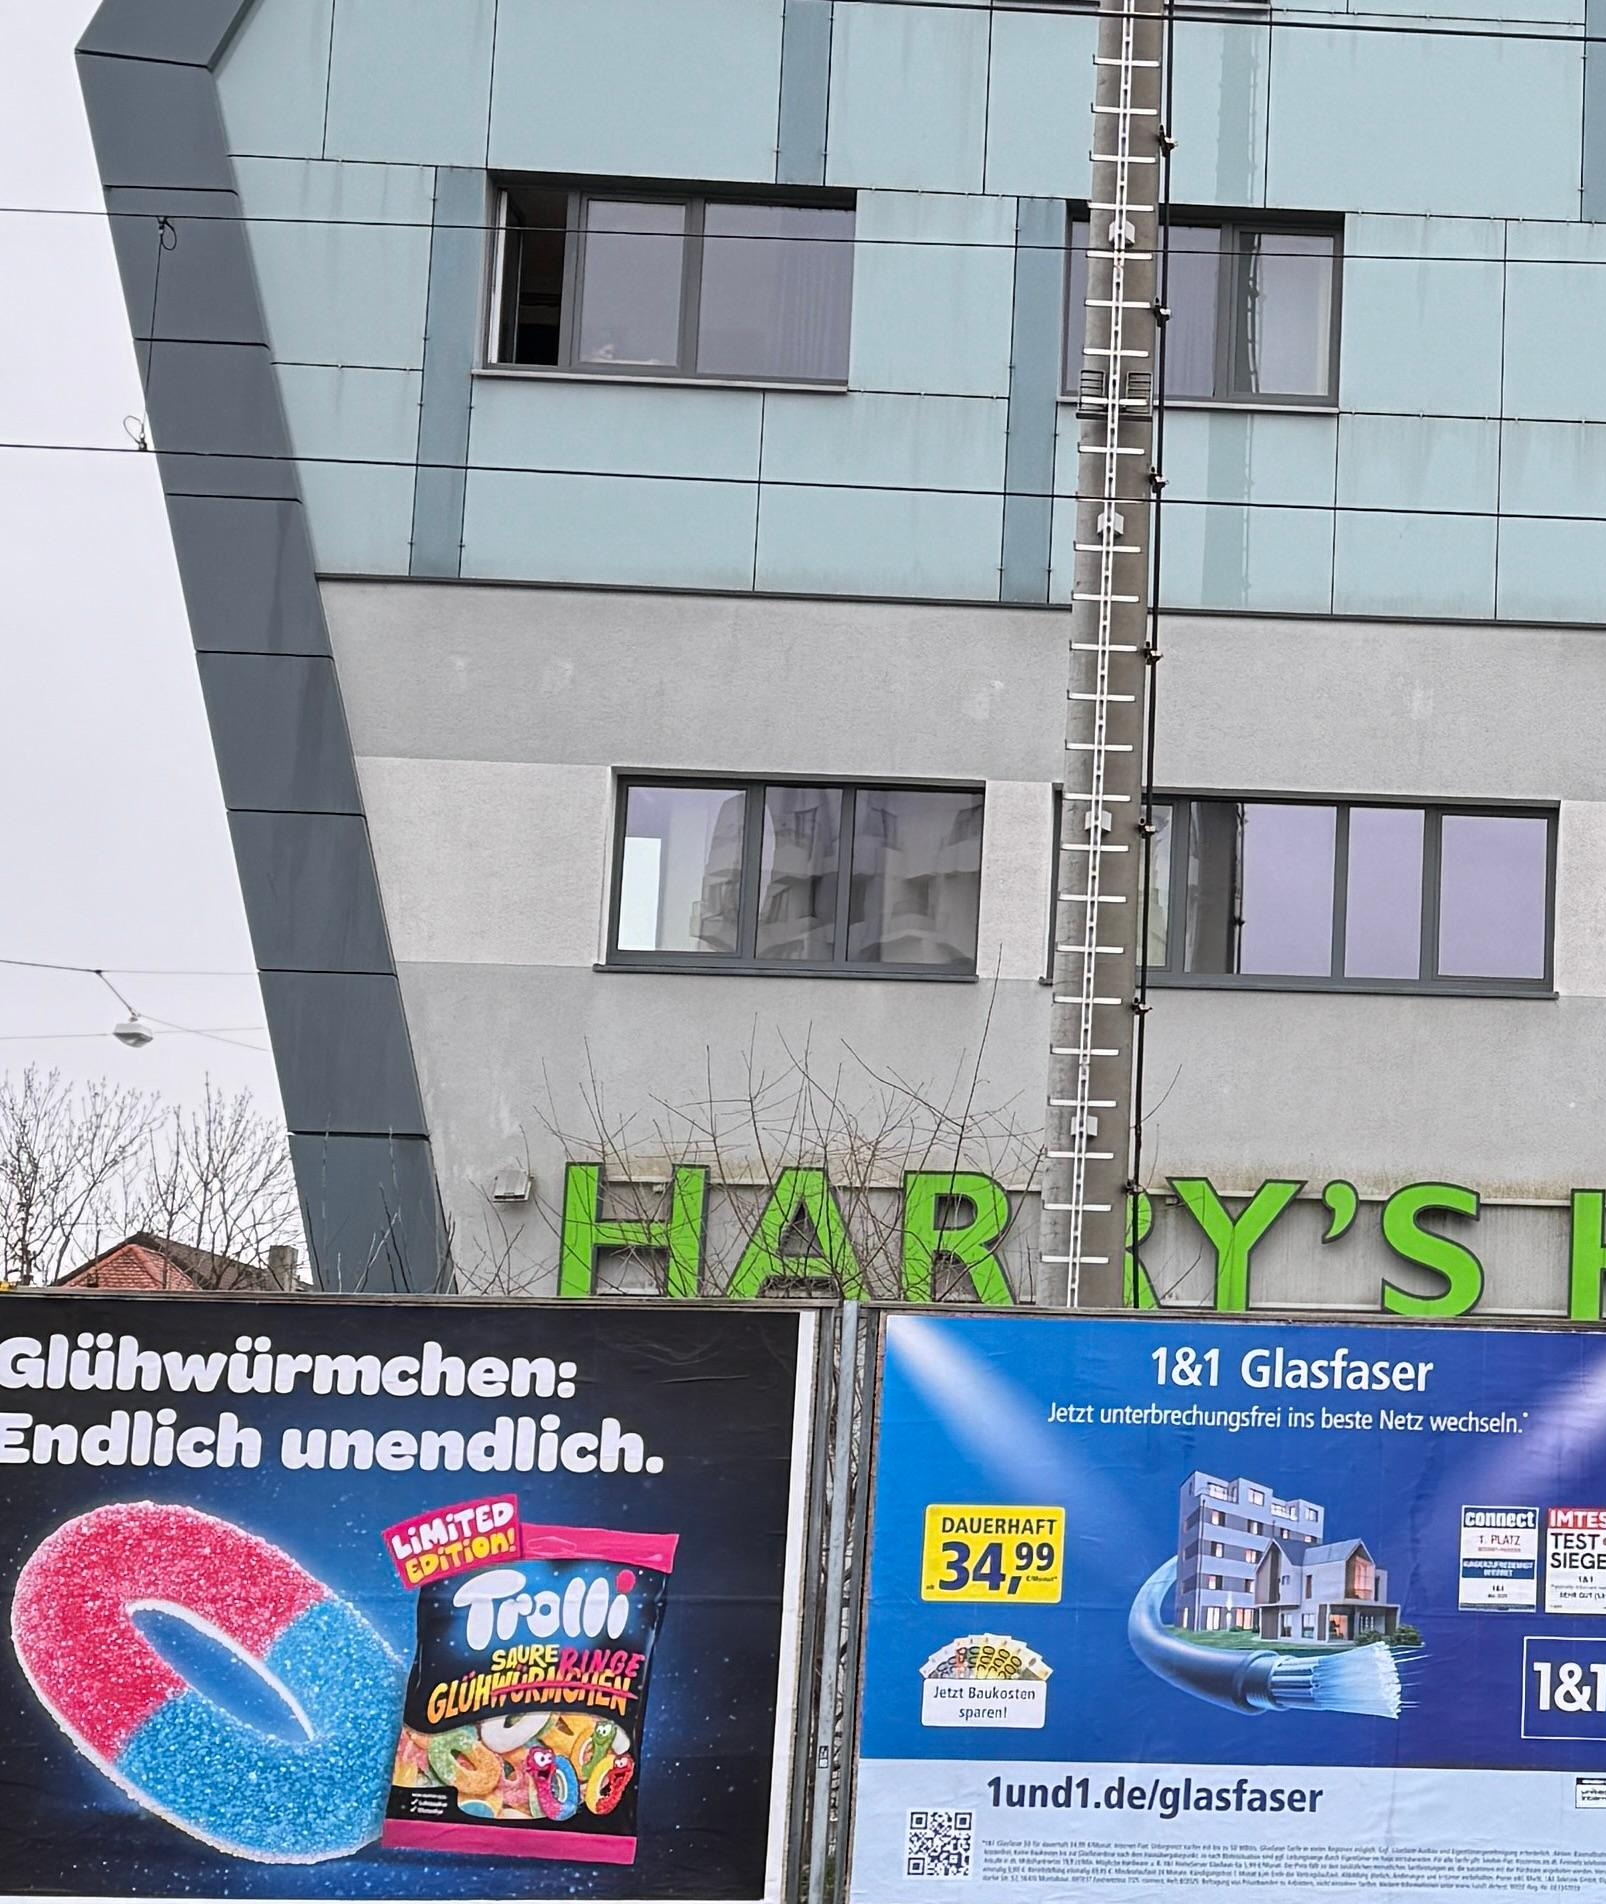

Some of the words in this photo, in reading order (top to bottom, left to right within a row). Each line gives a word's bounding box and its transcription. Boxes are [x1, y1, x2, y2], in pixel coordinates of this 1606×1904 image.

[0, 1333, 578, 1398] Glühwürmchen:
[1151, 1347, 1220, 1386] 1&1
[1240, 1347, 1434, 1392] Glasfaser
[1047, 1402, 1094, 1425] Jetzt
[1100, 1403, 1282, 1433] unterbrechungsfrei
[1288, 1407, 1315, 1429] ins
[1321, 1407, 1373, 1431] beste
[1380, 1410, 1424, 1431] Netz
[0, 1408, 261, 1468] Endlich
[281, 1413, 665, 1474] unendlich.
[941, 1517, 1057, 1535] DAUERHAFT
[1464, 1510, 1535, 1528] connect
[1491, 1534, 1521, 1546] PLATZ
[1550, 1532, 1600, 1550] TEST
[453, 1569, 636, 1650] Trolli
[491, 1644, 560, 1672] SAURE
[558, 1648, 646, 1679] RINGE
[427, 1664, 630, 1725] GLÜHWÜRMCHEN
[933, 1686, 963, 1700] Jetzt
[968, 1686, 1035, 1701] Baukosten
[958, 1705, 1007, 1721] sparen!
[987, 1775, 1323, 1819] 1und1.de/glasfaser
